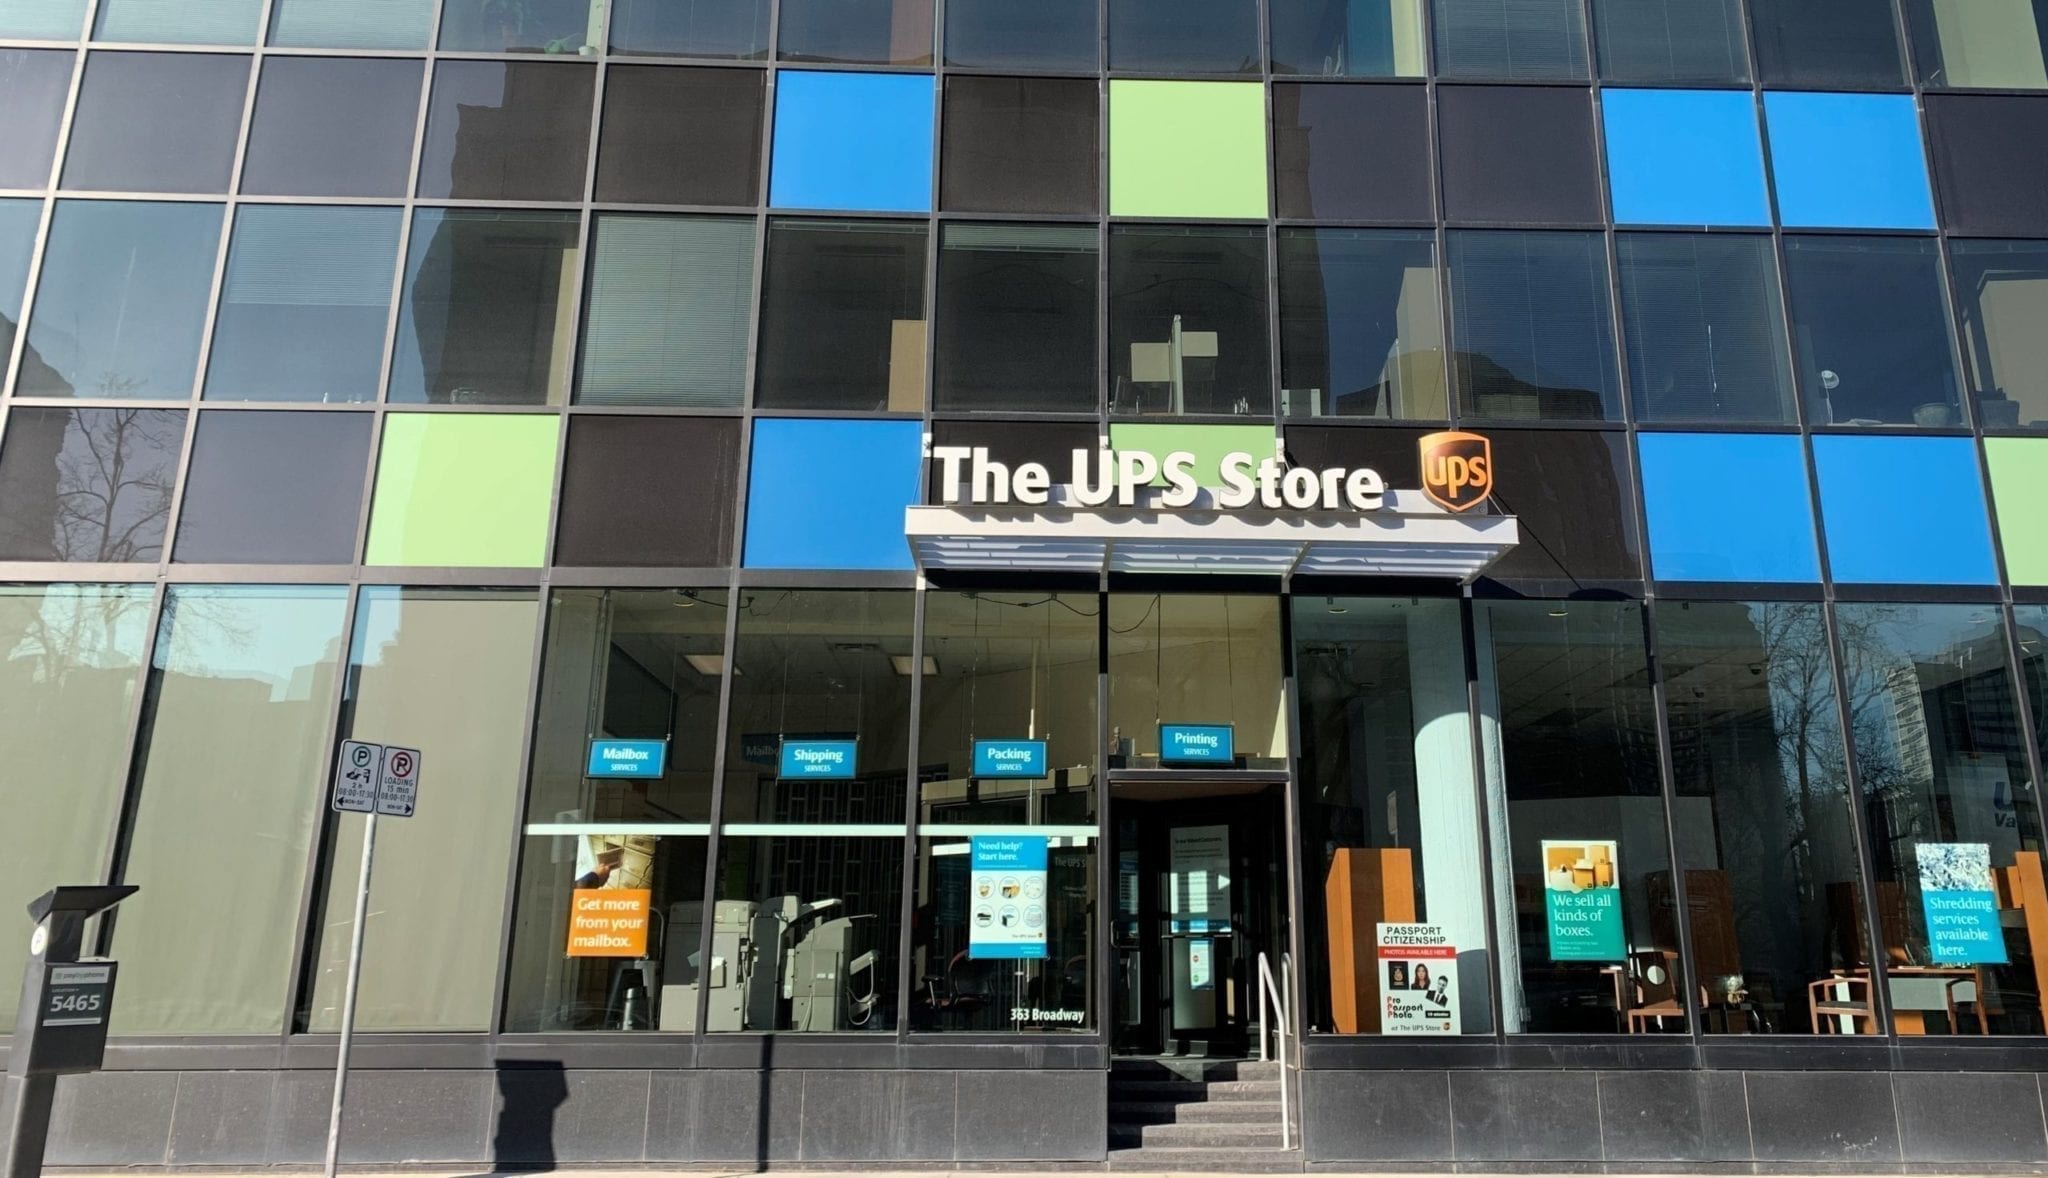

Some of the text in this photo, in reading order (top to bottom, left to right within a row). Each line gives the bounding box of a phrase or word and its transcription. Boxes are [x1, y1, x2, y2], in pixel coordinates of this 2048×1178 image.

[1425, 444, 1486, 498] ups
[933, 446, 1385, 511] The UPS Store
[1175, 732, 1218, 747] Printing
[603, 748, 648, 760] Mailbox
[794, 749, 843, 763] Shipping
[987, 747, 1031, 761] Packing
[1183, 748, 1210, 756] SERVICES
[610, 763, 638, 772] SERVICES
[804, 764, 831, 773] SERVICES
[996, 763, 1022, 771] SERVICES
[384, 777, 414, 787] LOADING
[979, 842, 1023, 852] Need help?
[978, 851, 1017, 861] Start here.
[578, 897, 639, 911] Get more
[1553, 894, 1611, 907] We sell all
[1930, 897, 1992, 912] Shredding
[1554, 909, 1603, 922] kinds of
[1933, 914, 1979, 925] services
[576, 915, 644, 932] from your
[1386, 926, 1442, 935] PASSPORT
[1555, 924, 1594, 937] boxes.
[1935, 928, 1989, 940] available
[573, 933, 632, 947] mailbox.
[1383, 936, 1446, 944] CITIZENSHIP
[1938, 943, 1967, 956] here.
[50, 995, 100, 1012] 5465
[1387, 996, 1401, 1004] Pro
[1387, 1004, 1423, 1012] Passport
[1010, 1008, 1085, 1024] 363 Broadway
[1387, 1011, 1413, 1019] Photo
